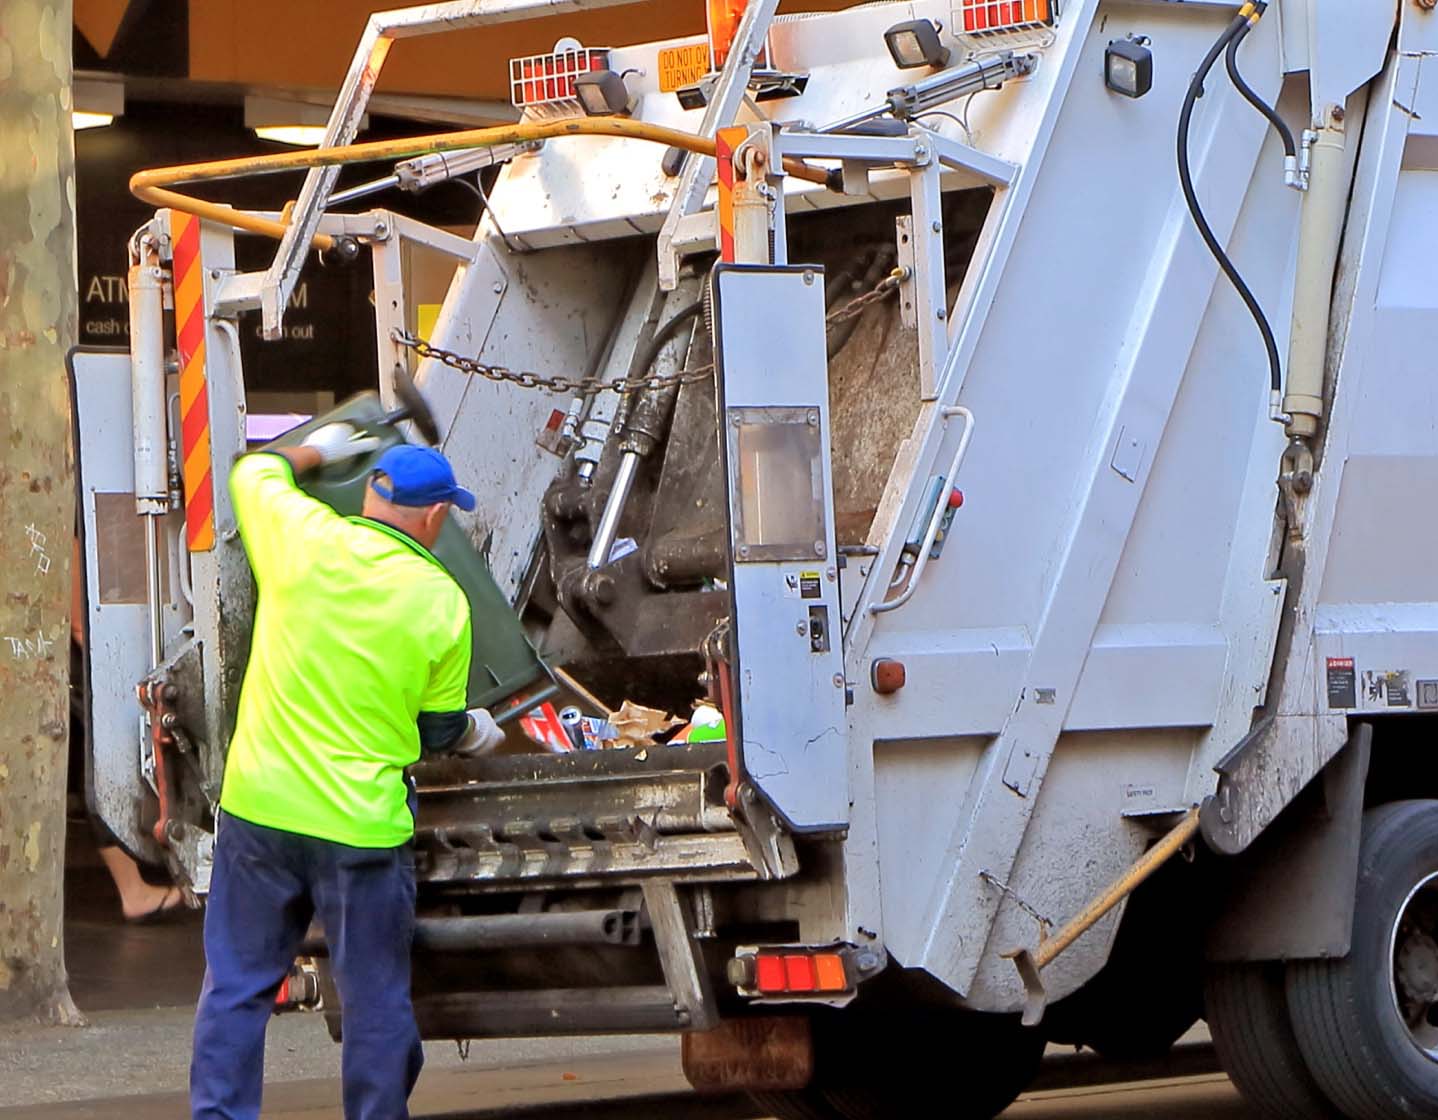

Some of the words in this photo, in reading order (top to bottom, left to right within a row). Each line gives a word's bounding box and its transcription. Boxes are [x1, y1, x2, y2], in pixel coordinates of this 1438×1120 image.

[663, 51, 674, 69] DO
[677, 49, 692, 67] NOT
[696, 46, 708, 64] OV
[665, 66, 701, 88] TURNING
[86, 319, 120, 336] cash
[291, 325, 313, 338] out
